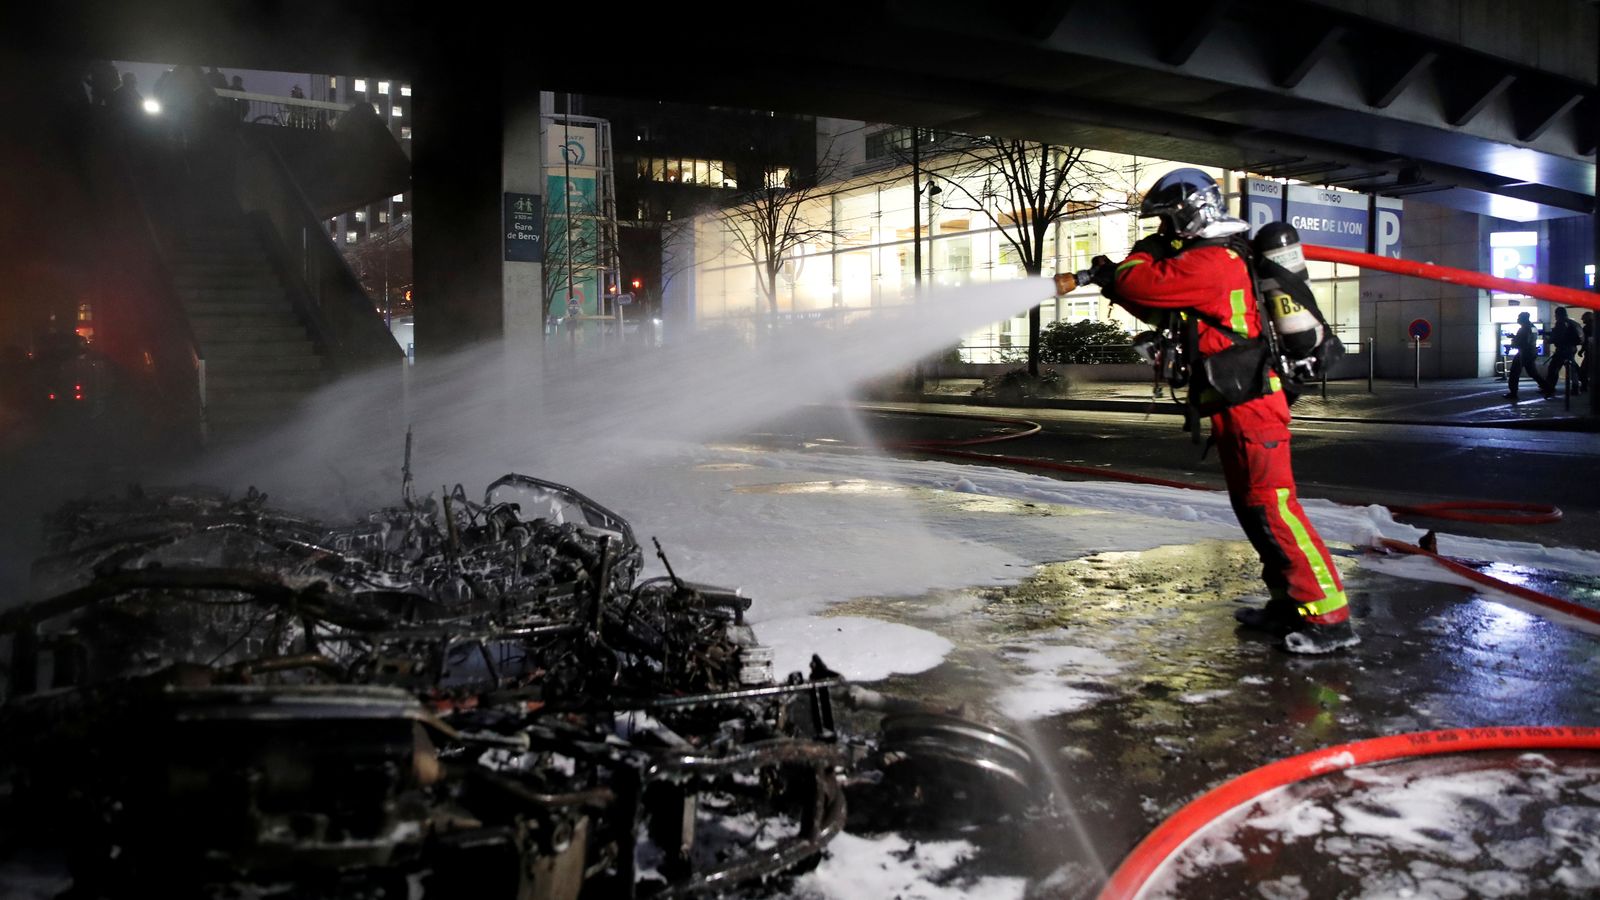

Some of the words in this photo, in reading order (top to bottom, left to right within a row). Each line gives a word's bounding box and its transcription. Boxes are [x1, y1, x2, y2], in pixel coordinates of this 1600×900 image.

[1253, 182, 1278, 194] INDIGO
[514, 222, 533, 231] Gare
[1251, 202, 1273, 240] P
[1291, 216, 1320, 231] GARE
[1322, 218, 1335, 232] DE
[1337, 220, 1363, 235] LYON
[507, 232, 517, 240] de
[518, 232, 540, 242] Bercy
[1378, 210, 1400, 257] P
[1493, 247, 1520, 278] P
